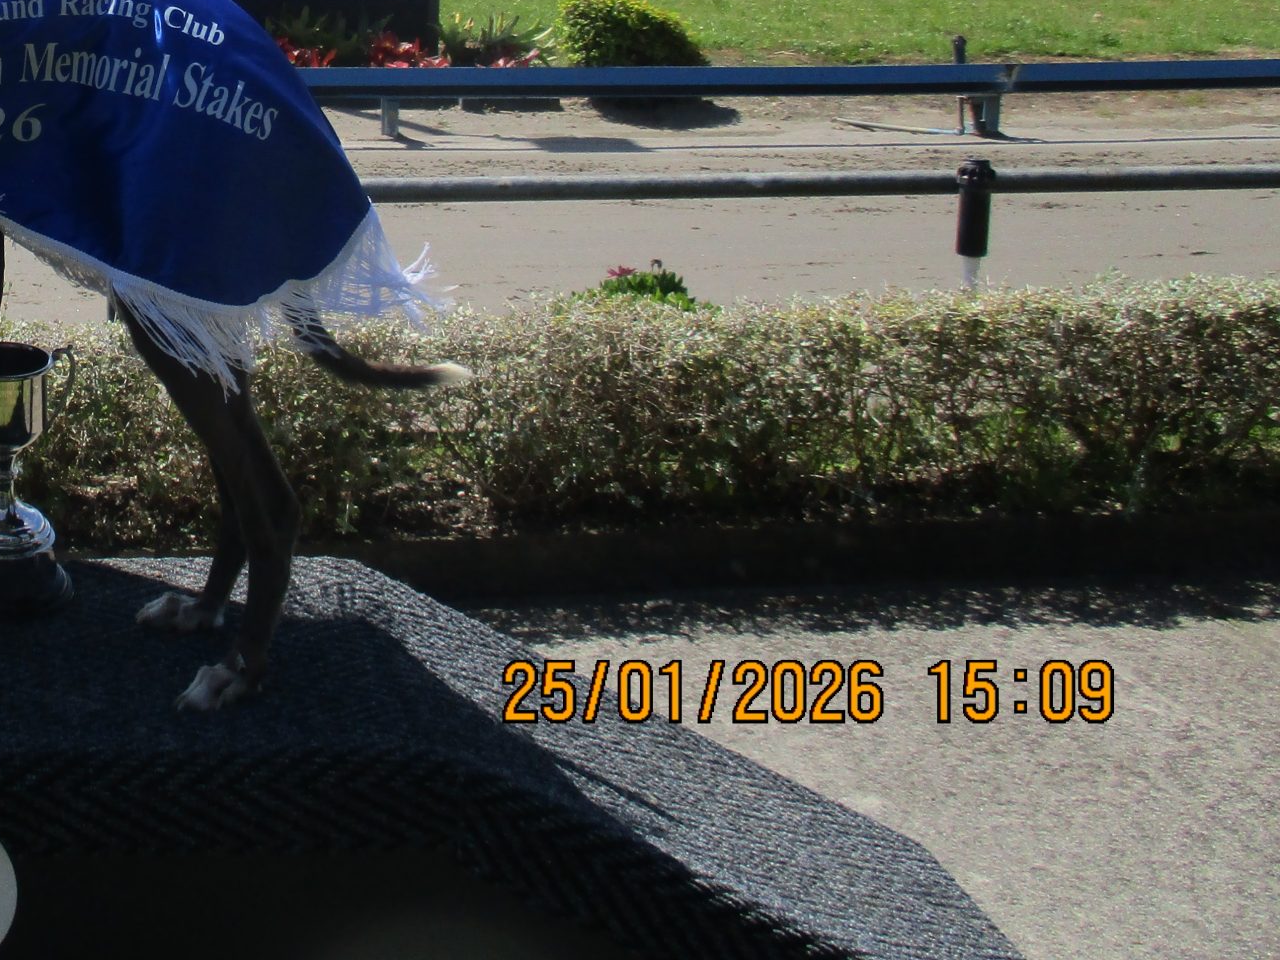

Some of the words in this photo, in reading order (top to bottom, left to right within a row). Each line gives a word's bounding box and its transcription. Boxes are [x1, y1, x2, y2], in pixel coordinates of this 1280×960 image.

[163, 5, 226, 47] Club
[20, 41, 170, 102] Memorial
[172, 61, 280, 142] Stakes
